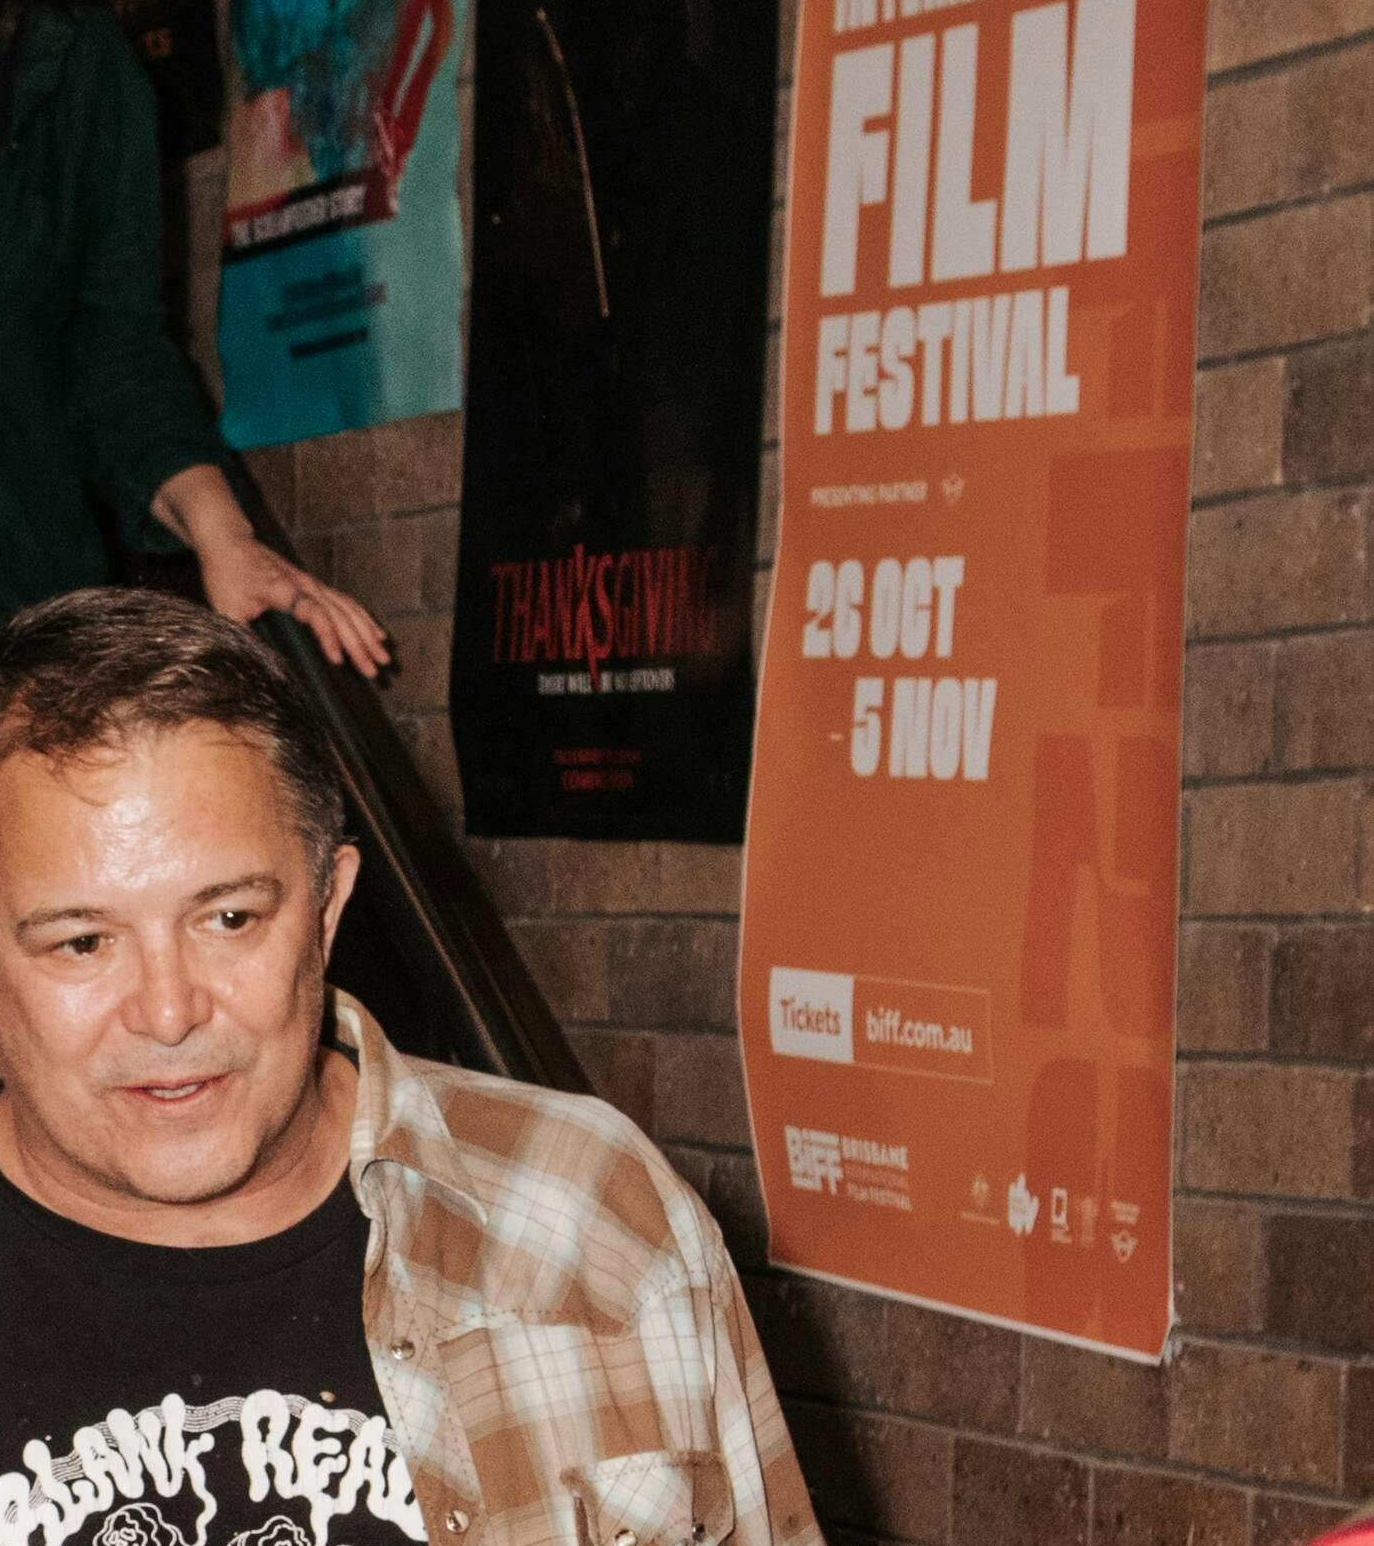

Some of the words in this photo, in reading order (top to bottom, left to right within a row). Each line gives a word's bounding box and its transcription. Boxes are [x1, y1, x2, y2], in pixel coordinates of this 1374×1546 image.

[813, 286, 1080, 436] FESTIVAL
[803, 559, 865, 659] 26
[869, 555, 966, 659] OCT
[851, 677, 885, 779] 5
[888, 676, 998, 781] NOV
[779, 995, 842, 1037] Tickets
[866, 1006, 974, 1055] biff.com.au
